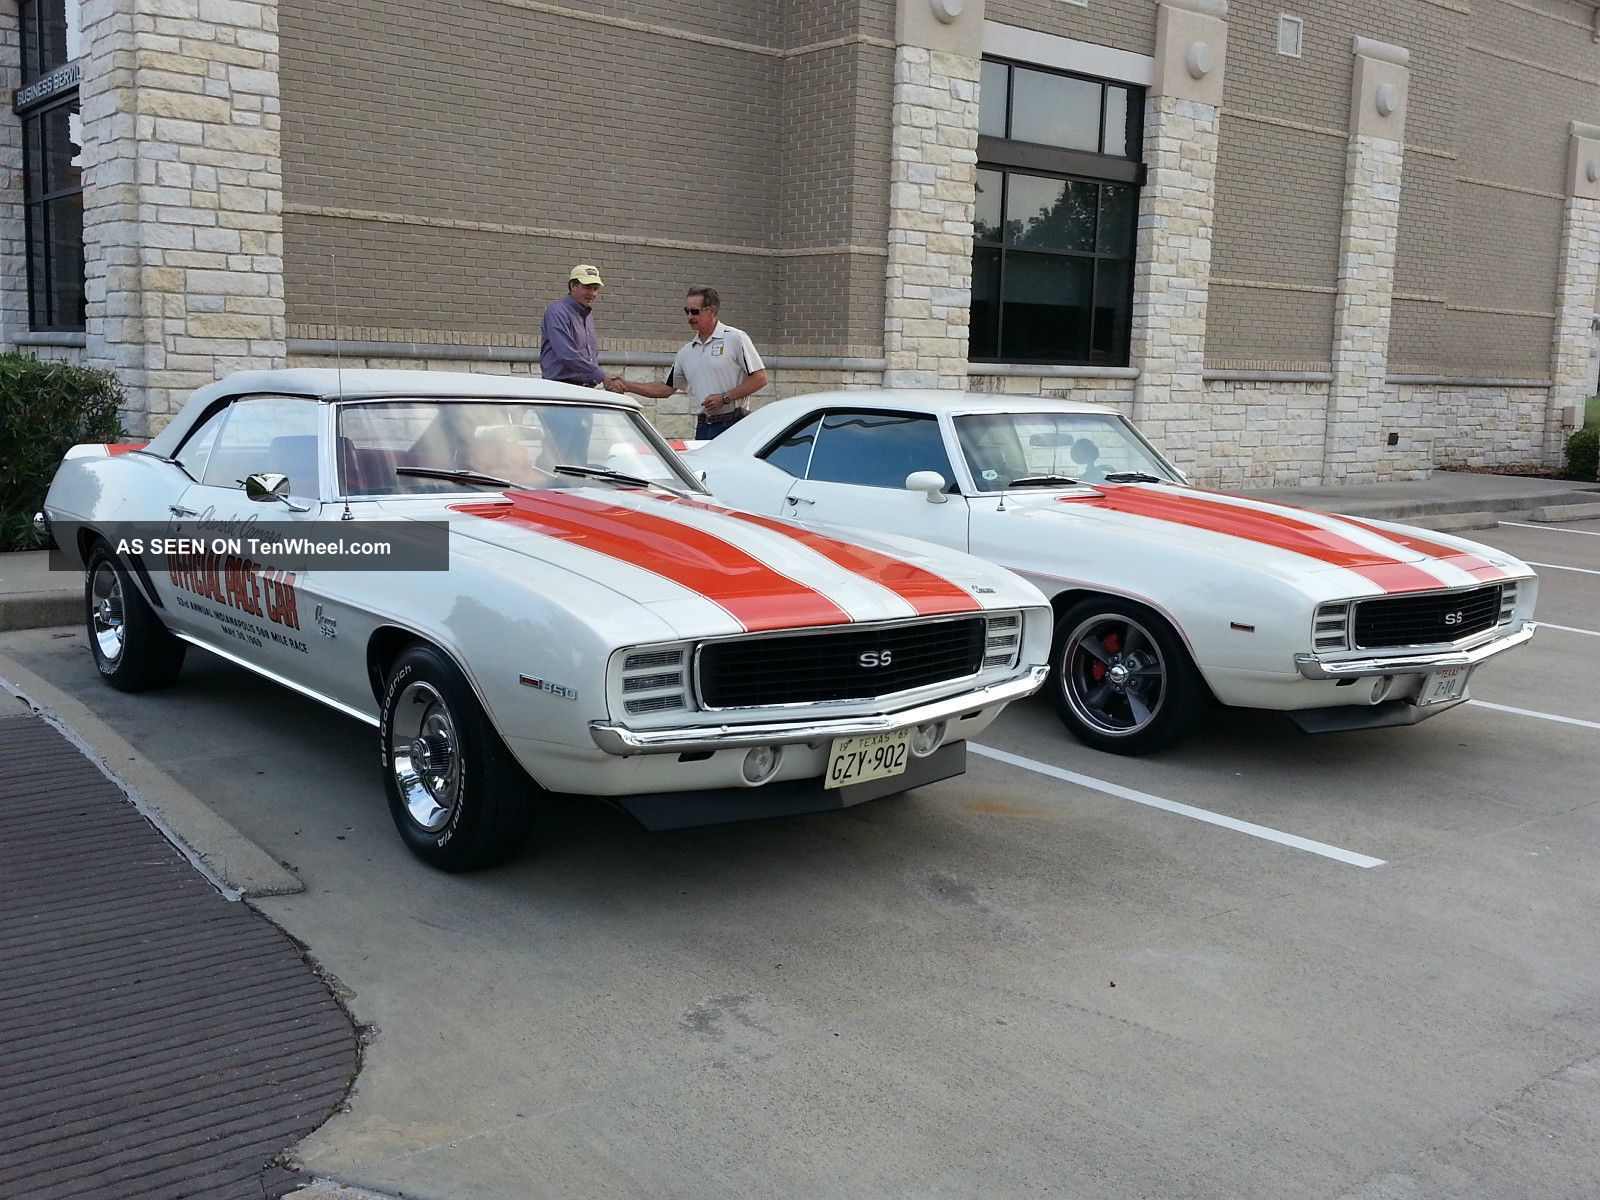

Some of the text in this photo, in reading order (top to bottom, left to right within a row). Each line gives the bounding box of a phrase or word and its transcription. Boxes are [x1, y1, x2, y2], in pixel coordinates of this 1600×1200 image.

[17, 77, 52, 106] BUSINESS
[225, 554, 263, 618] PACE
[263, 565, 300, 631] CAR
[1445, 611, 1463, 625] SS
[190, 601, 214, 618] ANNUAL
[213, 609, 256, 633] INDIANAPOLIS
[255, 626, 270, 640] 500
[270, 631, 289, 647] MILE
[288, 638, 309, 654] RACE
[221, 624, 236, 637] MAY
[859, 649, 892, 668] SS
[541, 683, 577, 700] 350
[859, 733, 890, 747] TEXAS
[437, 831, 452, 847] T/A
